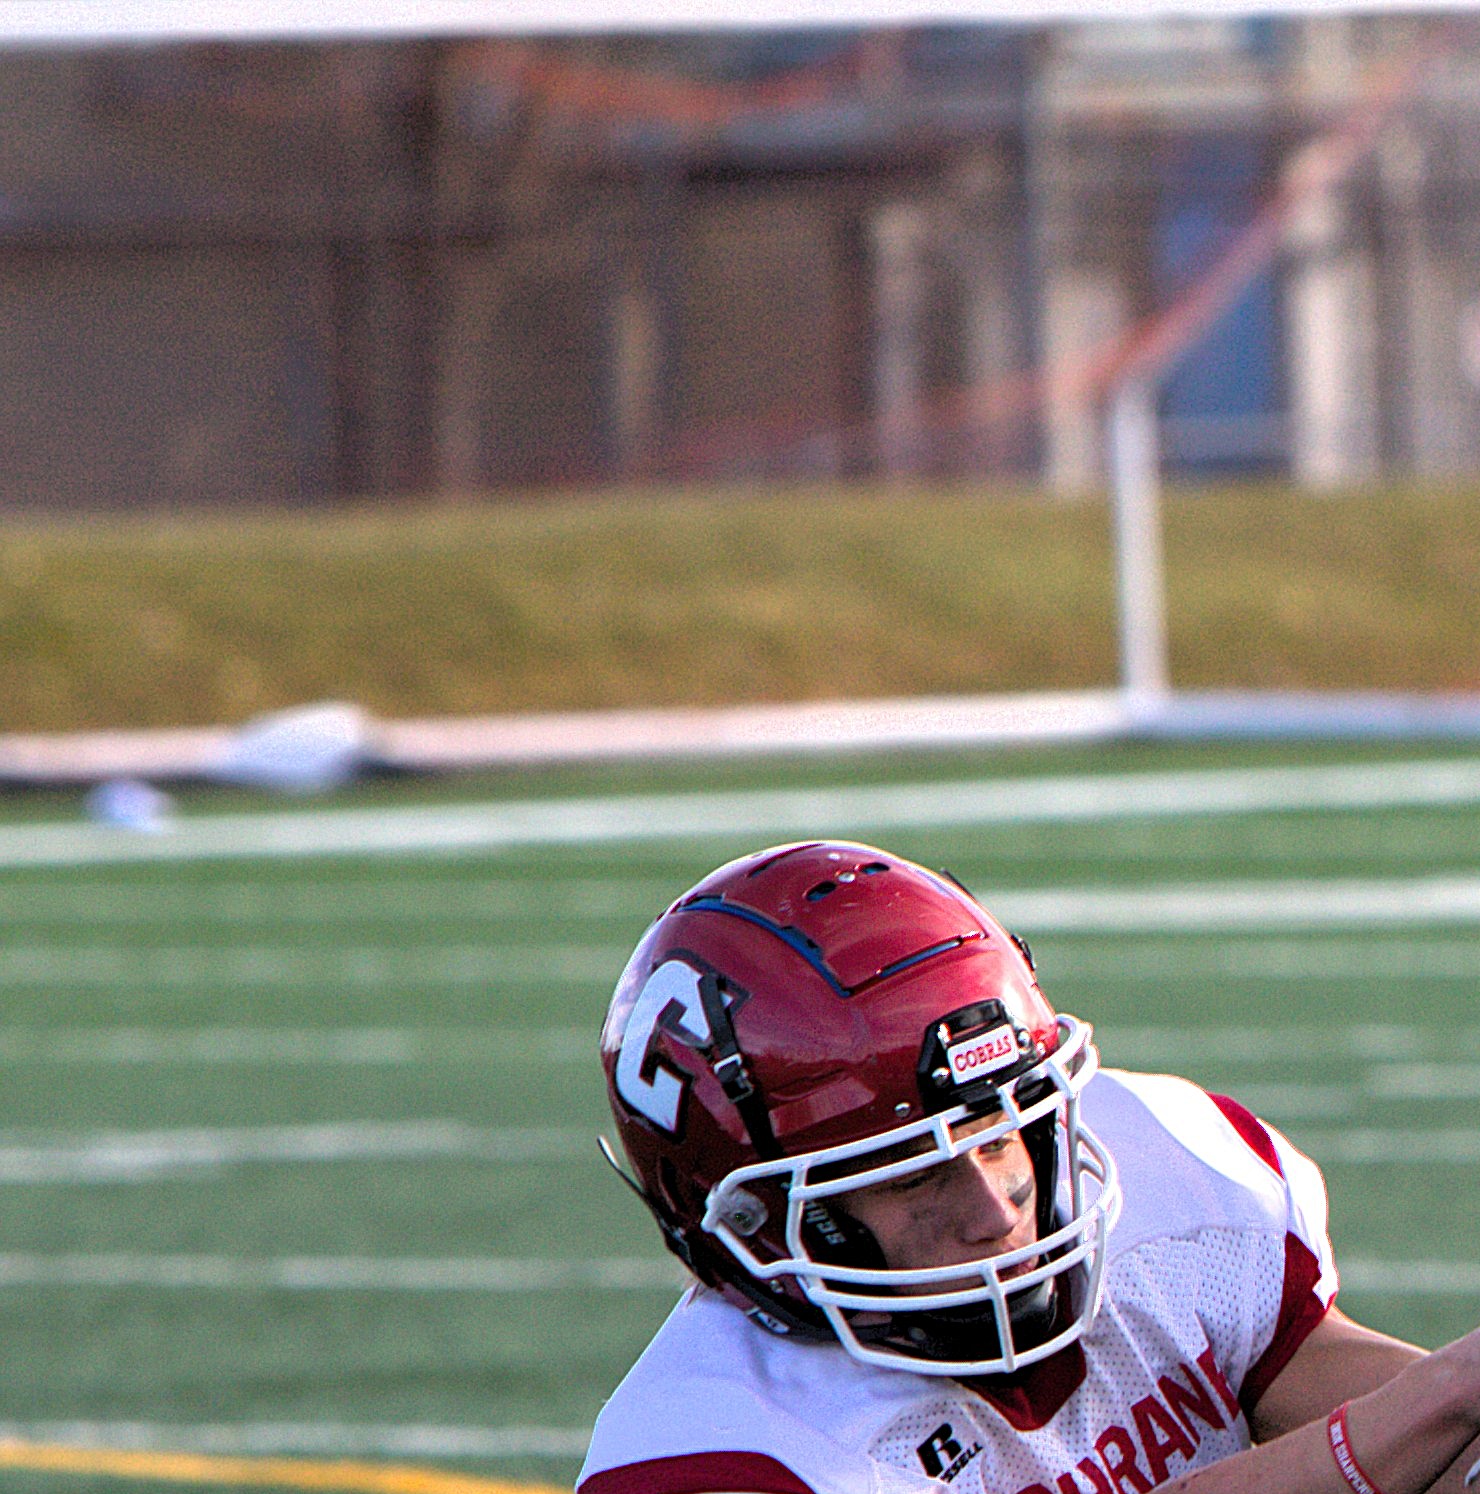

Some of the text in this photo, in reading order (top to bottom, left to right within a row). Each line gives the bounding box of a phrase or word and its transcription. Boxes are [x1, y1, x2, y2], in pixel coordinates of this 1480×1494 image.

[614, 956, 742, 1136] C
[953, 1035, 1012, 1073] COBRAS
[916, 1423, 962, 1478] R
